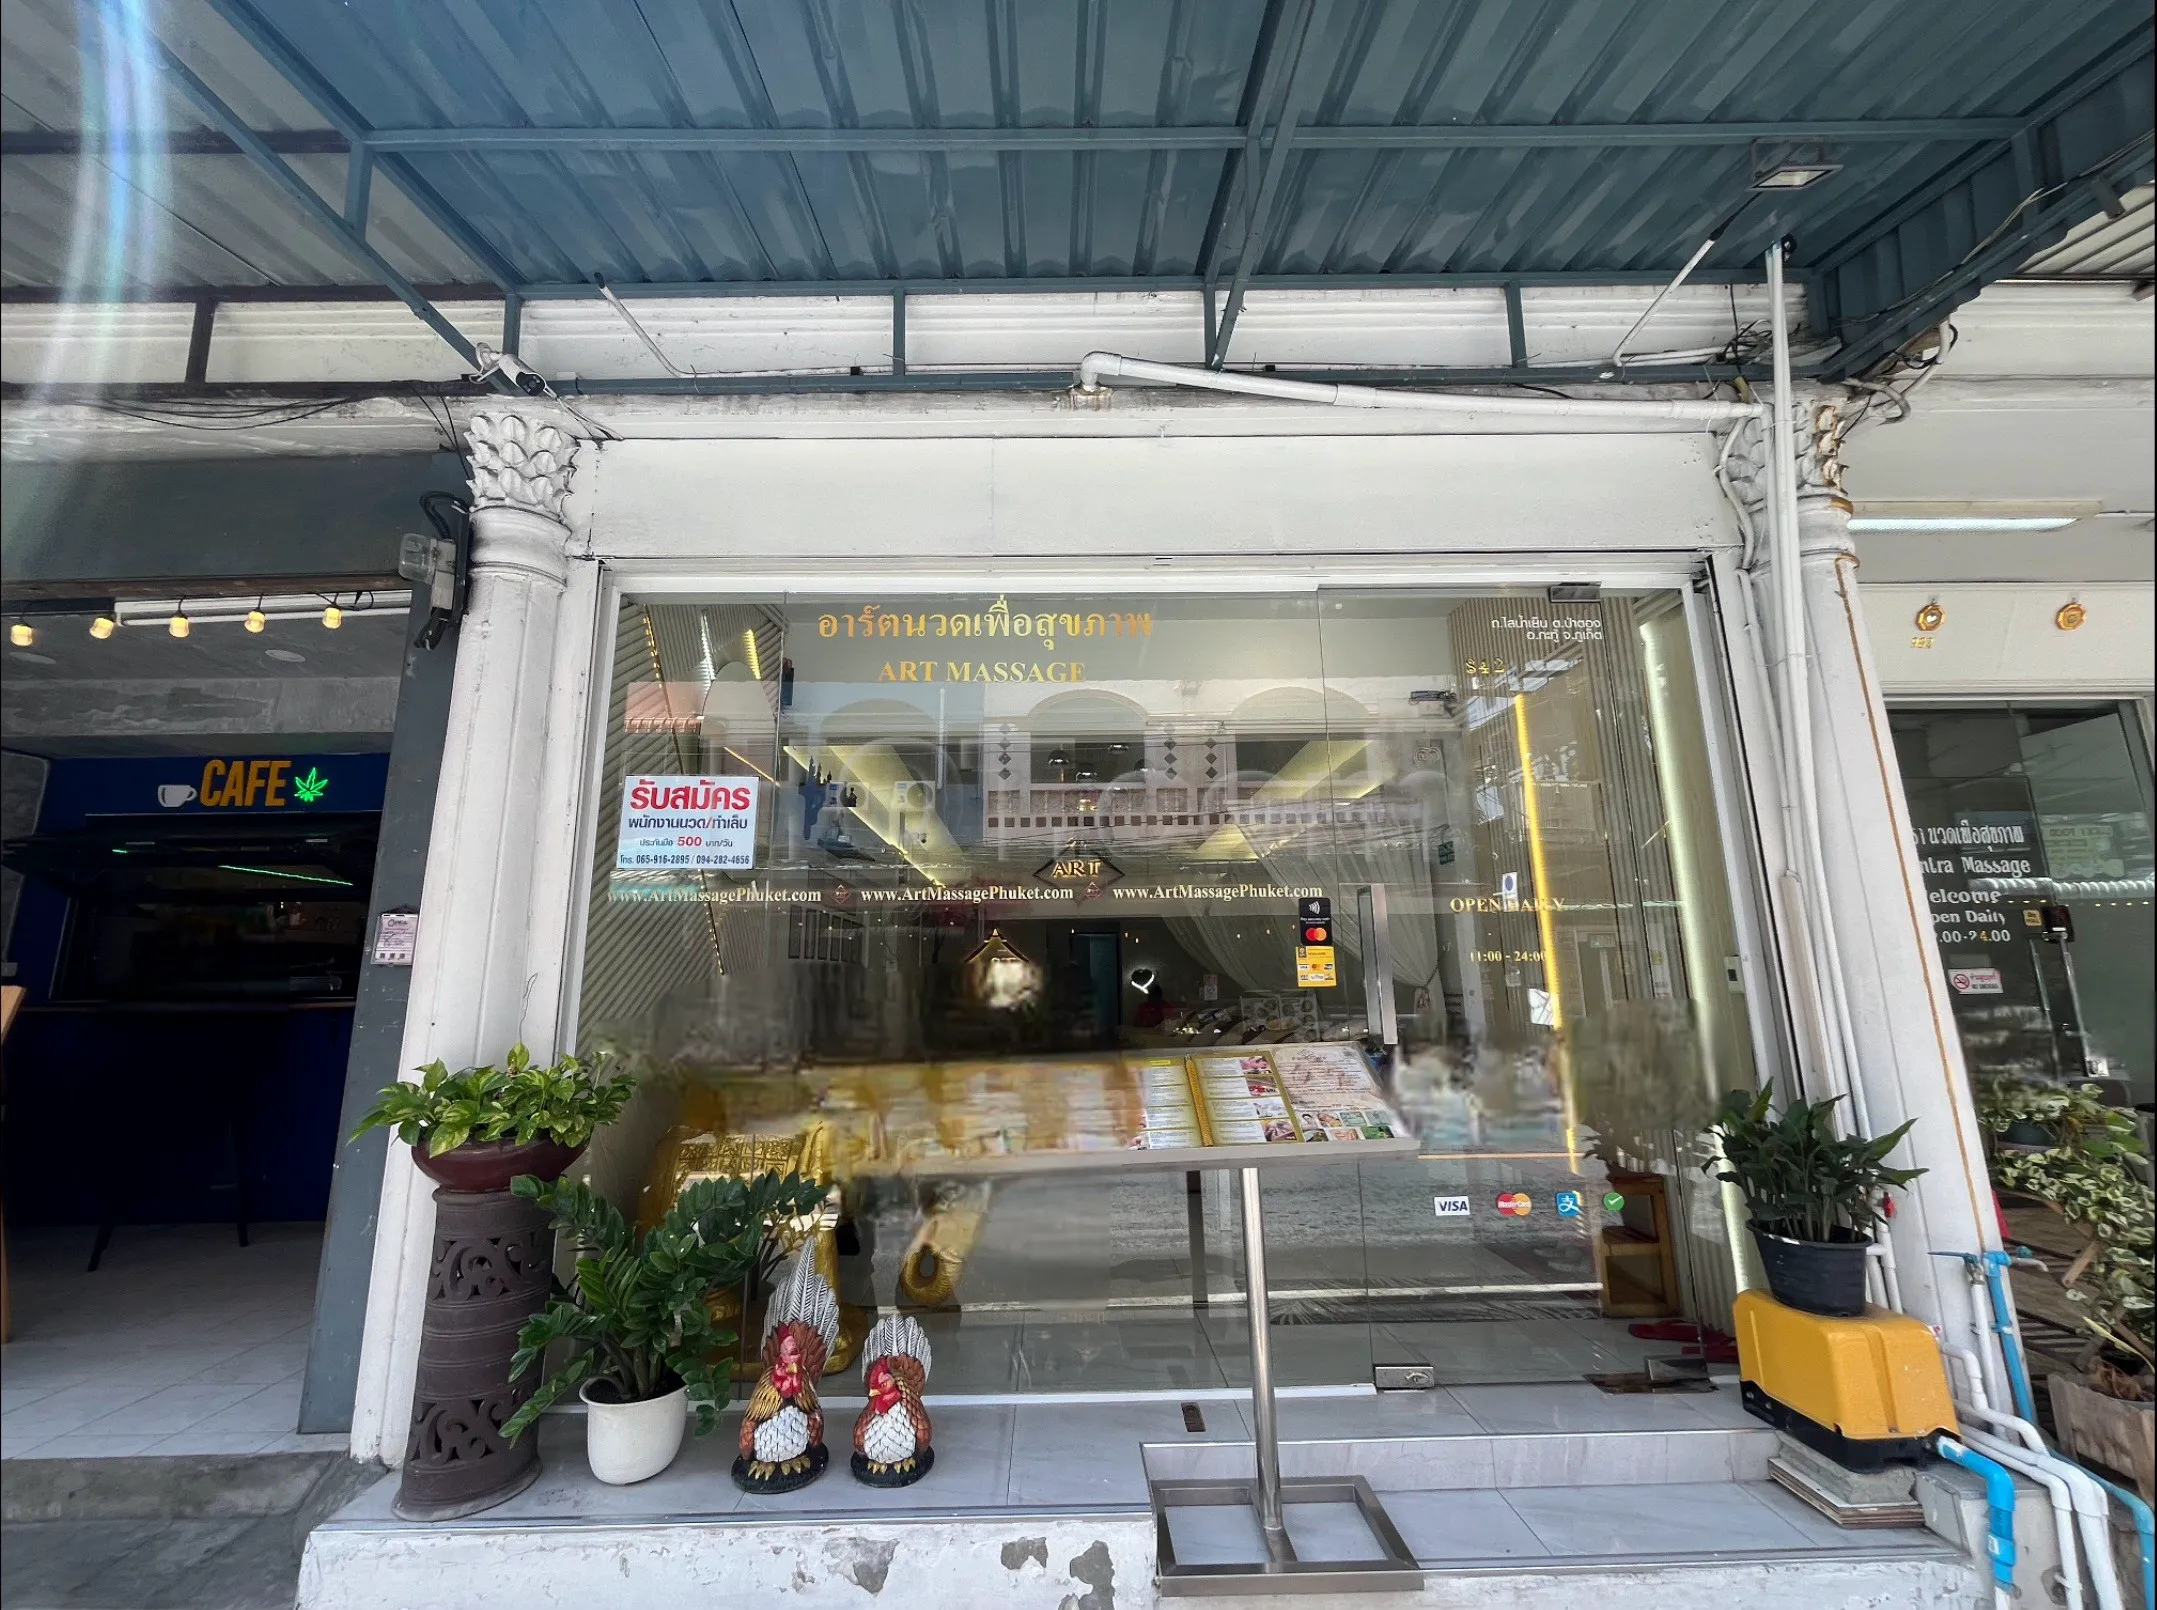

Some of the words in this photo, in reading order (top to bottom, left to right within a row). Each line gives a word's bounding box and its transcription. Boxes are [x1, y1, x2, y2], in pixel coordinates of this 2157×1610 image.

[818, 594, 1153, 651] อาร์ตนวดเพื่อสุขภาพ
[878, 661, 937, 682] ART
[946, 661, 1087, 683] MASSAGE
[200, 759, 292, 807] CAFE
[629, 778, 751, 810] รับสมัคร
[628, 814, 747, 829] พนักงานนวด/ทำเล็บ
[677, 836, 702, 847] 500
[636, 854, 690, 865] 065-916-2895
[1961, 856, 2031, 877] Massage
[1053, 860, 1101, 878] ART
[607, 887, 822, 903] www.ArtMassagePhuket.com
[861, 887, 1074, 903] www.ArtMassagePhuket.com
[1113, 884, 1323, 901] www.ArtMassagePhuket.com
[1929, 888, 2001, 903] elcome
[1450, 897, 1500, 913] OPEN
[1965, 909, 2006, 925] Daily
[1470, 950, 1502, 962] 11:00
[1439, 1201, 1468, 1212] VISA
